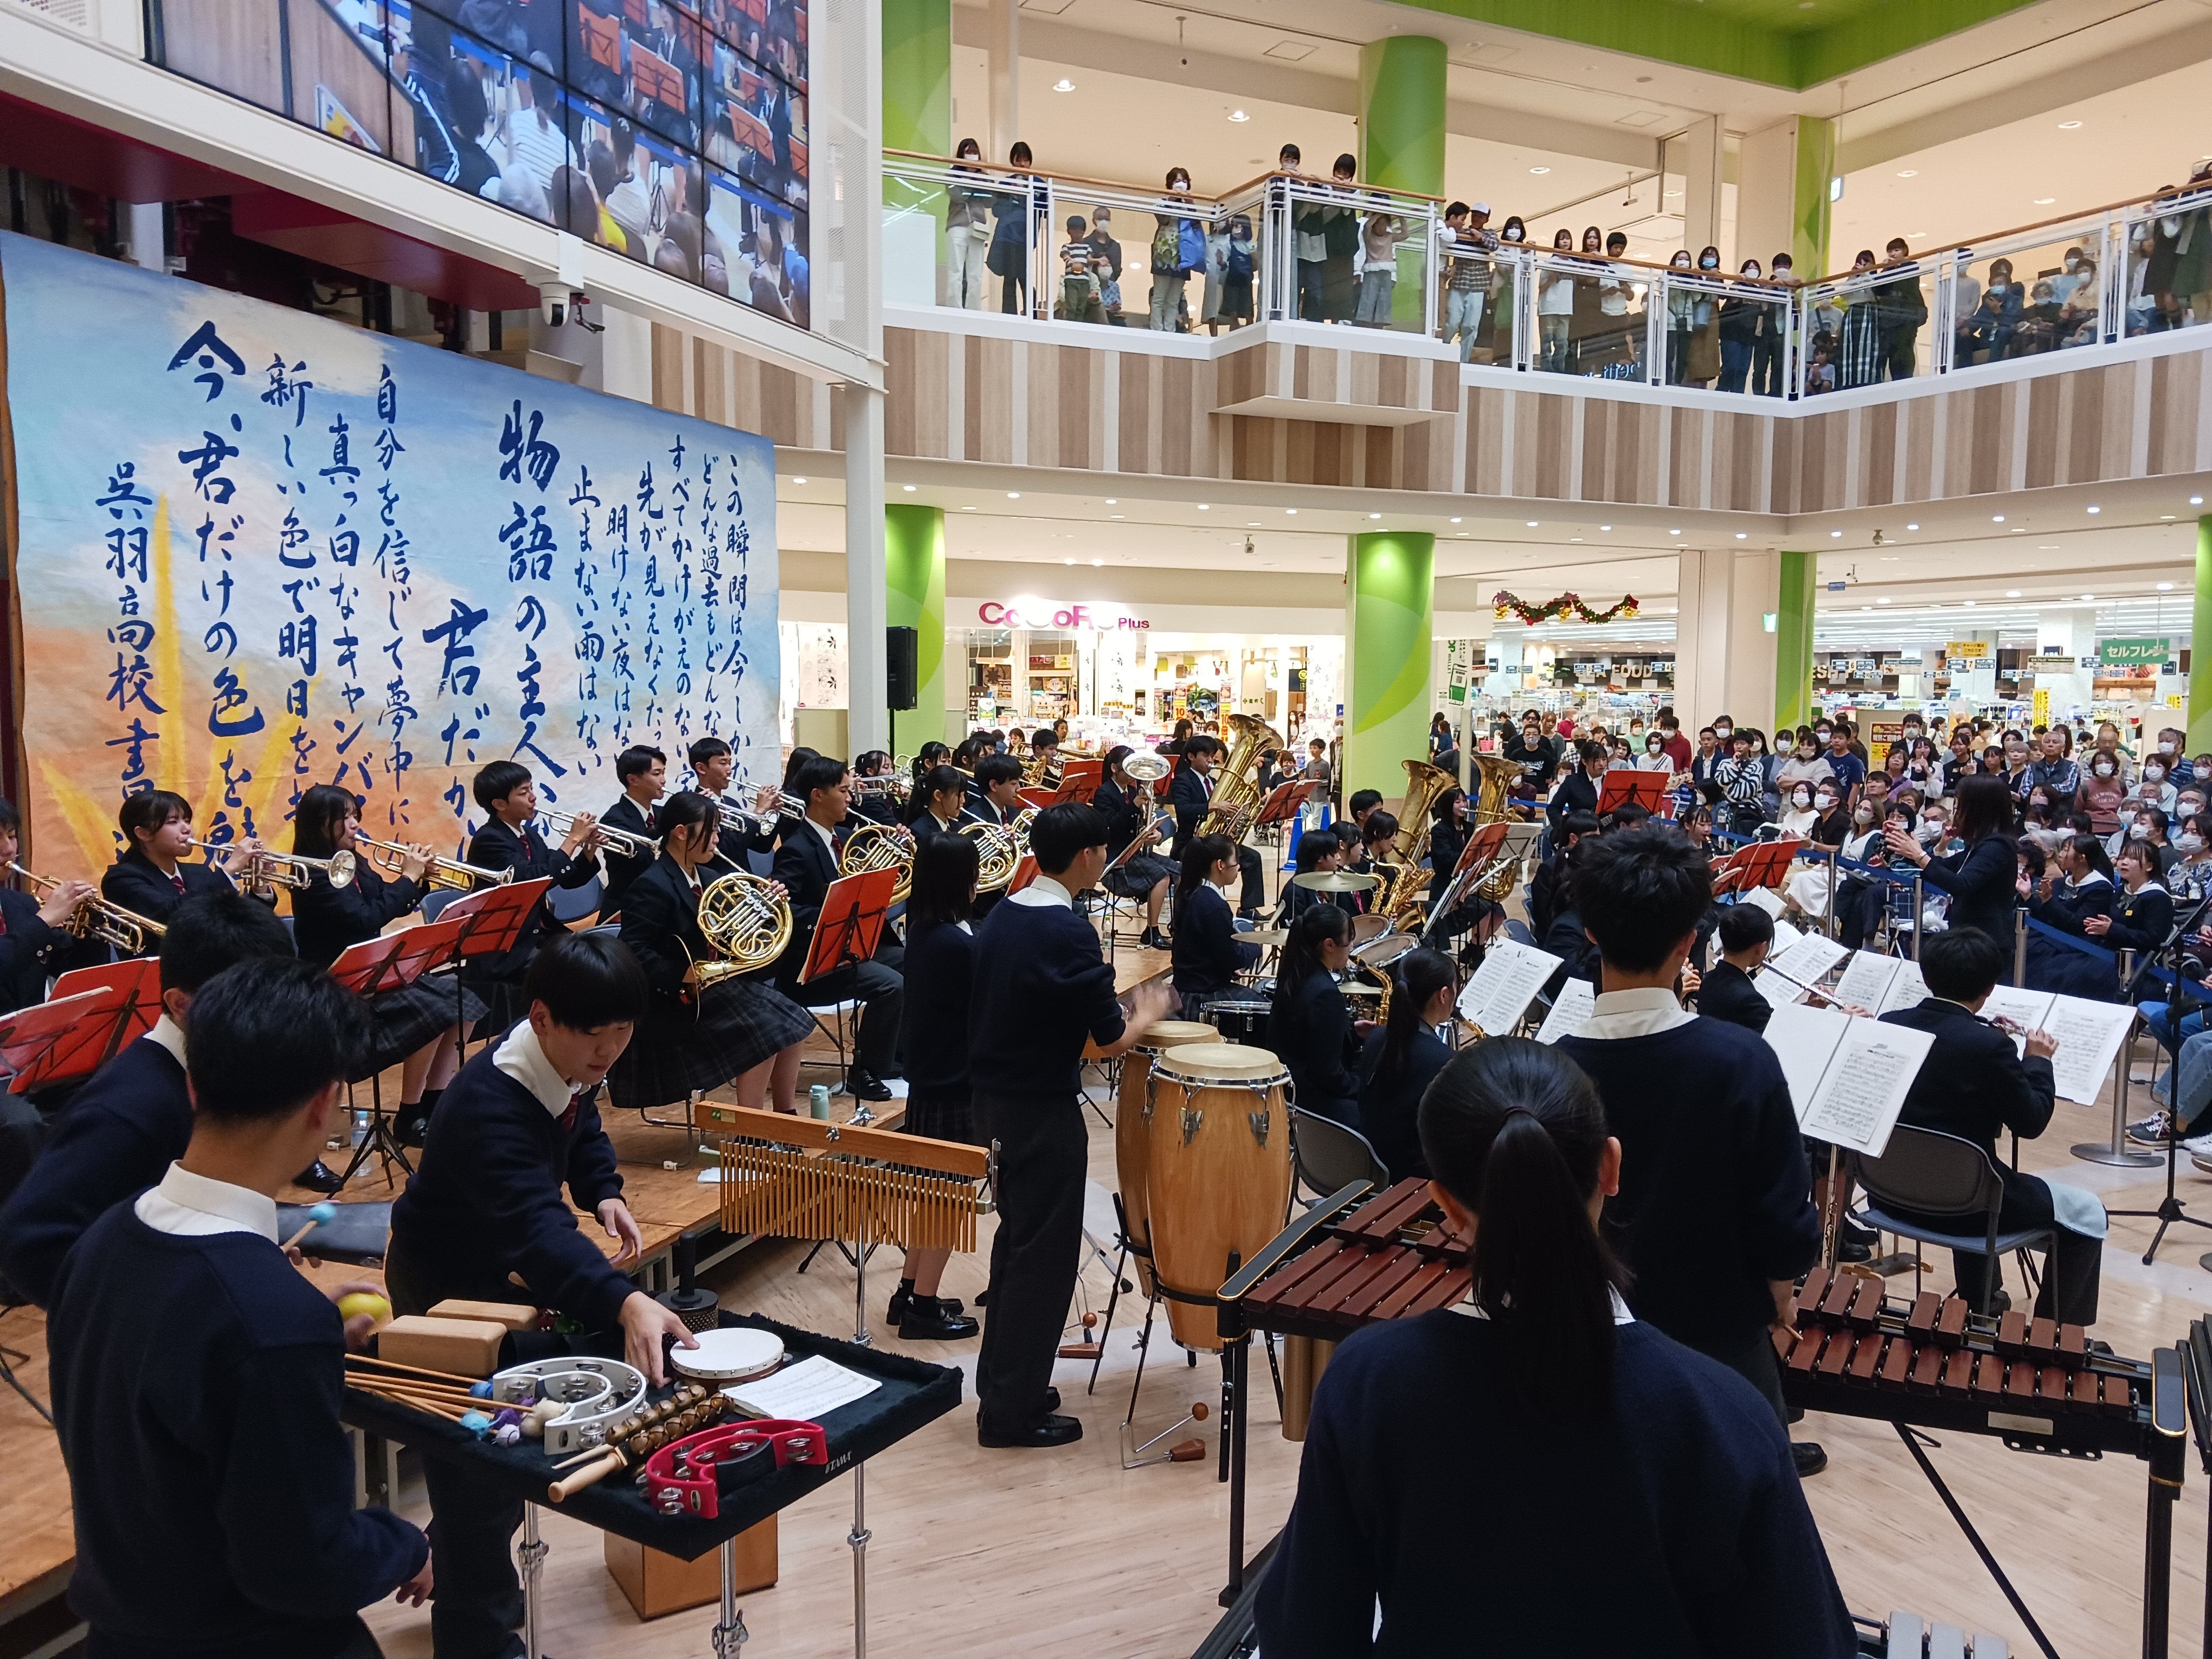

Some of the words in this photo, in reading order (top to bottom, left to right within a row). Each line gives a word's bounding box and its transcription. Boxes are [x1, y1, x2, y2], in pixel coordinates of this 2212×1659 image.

[95, 462, 167, 863] 呉羽高校書
[319, 413, 373, 808] 真っ白なキャンバ
[372, 364, 418, 861] 自分を信じて夢中に
[568, 465, 605, 775] 止まない雨はない
[606, 504, 635, 764] 明けない夜はな
[637, 461, 666, 751] 先が見えなくたっ
[1118, 618, 1149, 628] Plus
[1611, 664, 1652, 678] FOOD
[2107, 645, 2164, 658] セルフレジ
[1175, 708, 1185, 716] 10
[1221, 713, 1230, 724] 10
[1882, 748, 1888, 758] 5
